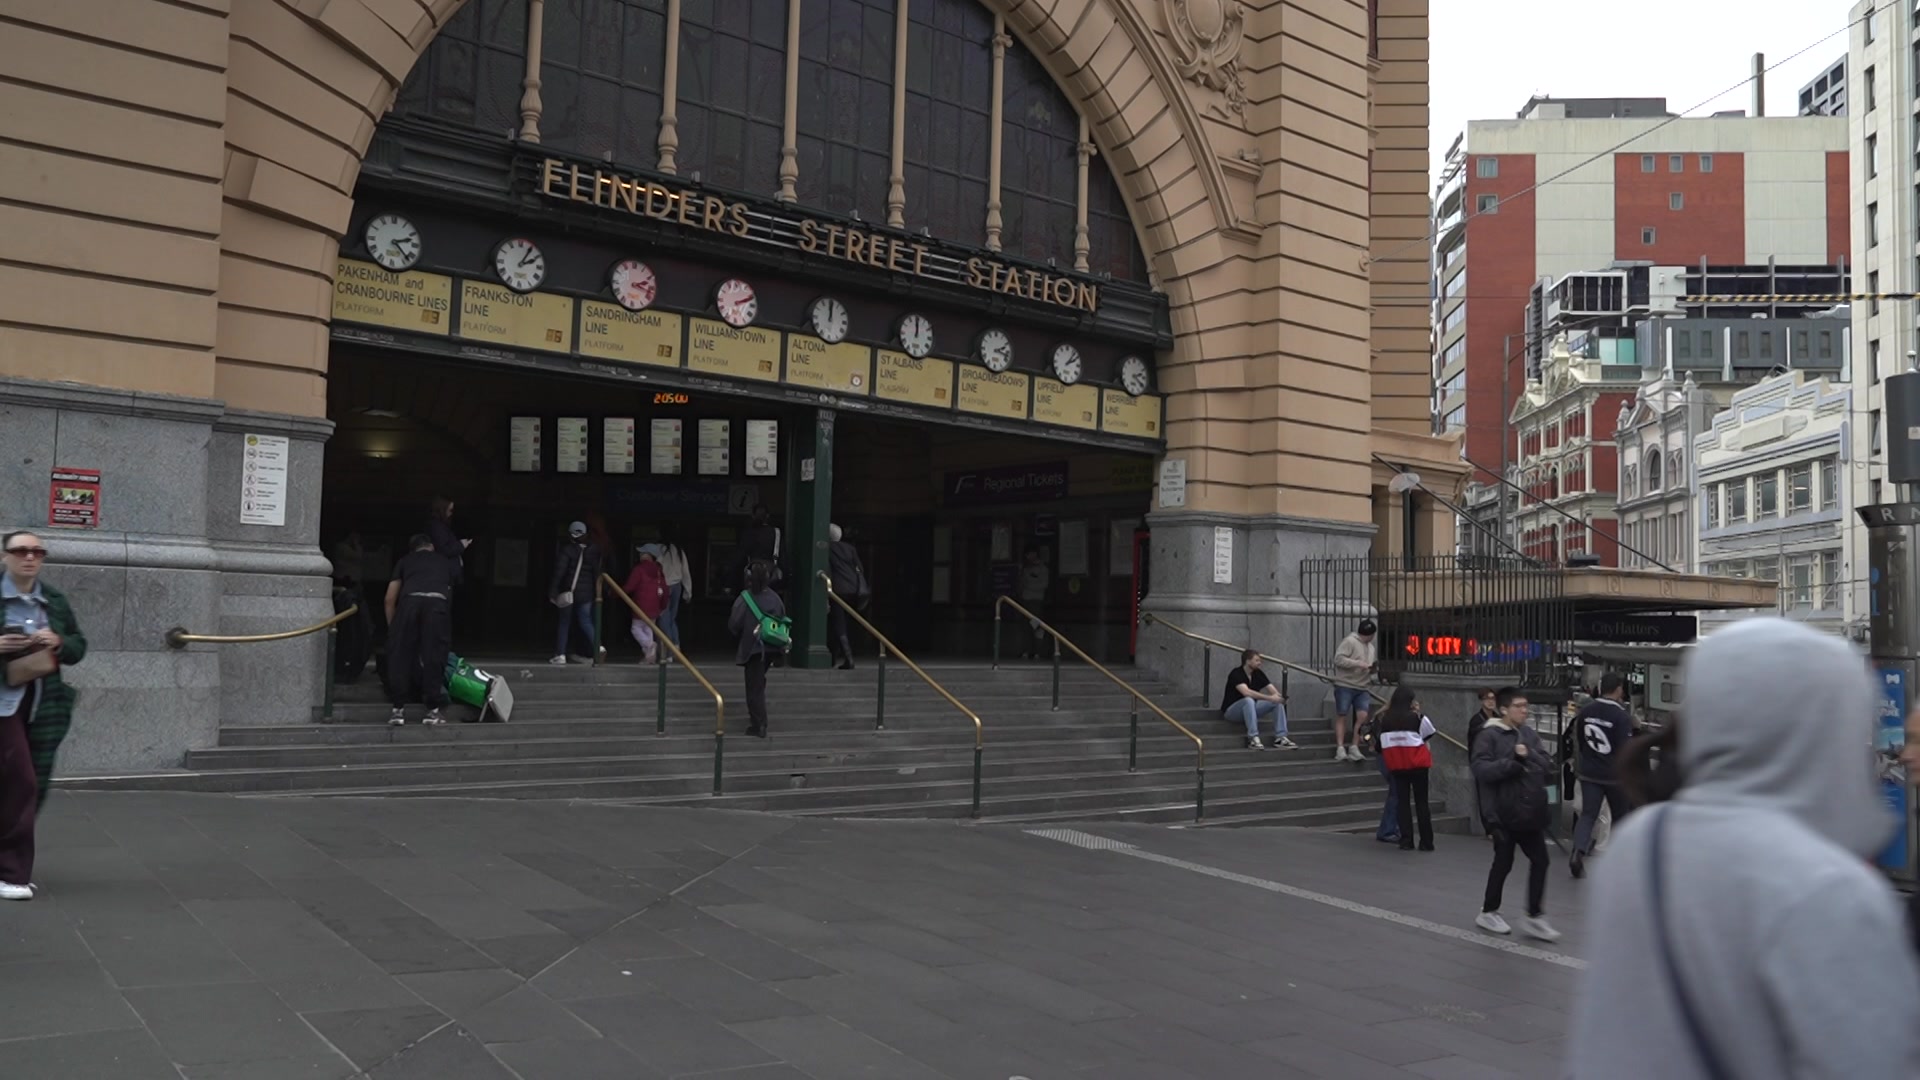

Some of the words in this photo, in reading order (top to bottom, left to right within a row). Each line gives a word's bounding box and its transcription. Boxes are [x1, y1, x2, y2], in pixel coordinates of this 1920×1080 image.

[543, 158, 748, 237] FLINDERS
[800, 218, 928, 275] STREET
[967, 256, 1098, 312] STATION
[336, 264, 400, 287] PAKENHAM
[405, 276, 424, 291] and
[336, 281, 416, 306] CRANBOURNE
[417, 295, 448, 312] LINES
[464, 286, 534, 308] FRANKSTON
[335, 300, 384, 317] PLATFORM
[464, 304, 489, 317] LINE
[586, 305, 662, 327] SANDRINGHAM
[462, 320, 507, 335] PLATFORM
[585, 321, 608, 336] LINE
[695, 323, 766, 344] WILLIAMSTOWN
[584, 340, 624, 352] PLATFORM
[694, 338, 715, 352] LINE
[792, 339, 826, 354] ALTONA
[693, 355, 728, 367] PLATFORM
[791, 352, 810, 365] LINE
[880, 354, 890, 365] ST
[892, 356, 924, 371] ALBANS
[790, 368, 824, 381] PLATFORM
[880, 369, 898, 380] LINE
[962, 369, 1025, 389] BROADMEADOWS
[879, 383, 910, 395] PLATFORM
[961, 382, 978, 394] LINE
[1037, 381, 1065, 394] UPFIELD
[1036, 394, 1052, 405] LINE
[1105, 405, 1120, 416] LINE
[983, 475, 1026, 492] Regional
[1028, 472, 1064, 486] Tickets
